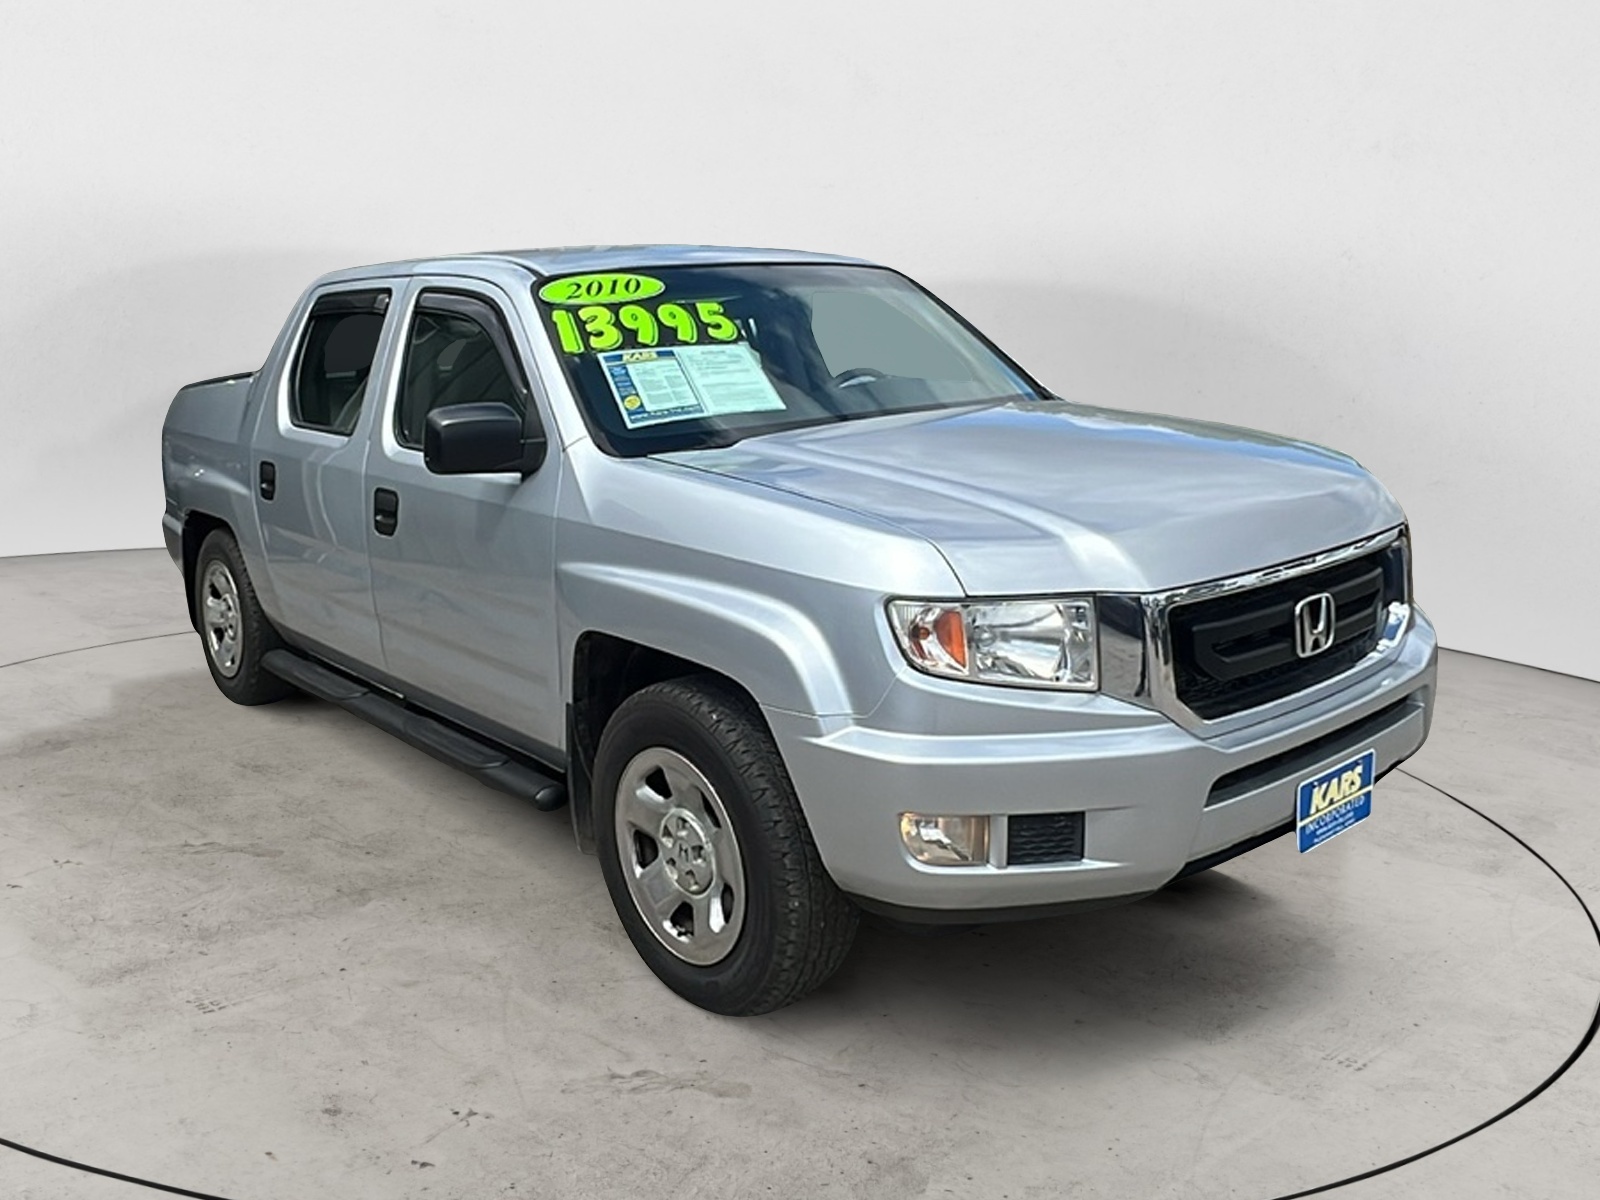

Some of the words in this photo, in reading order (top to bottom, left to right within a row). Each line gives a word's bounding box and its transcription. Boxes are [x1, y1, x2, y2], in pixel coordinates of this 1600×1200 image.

[567, 279, 641, 300] 2010
[552, 302, 738, 354] 13995
[1310, 765, 1363, 815] KARS
